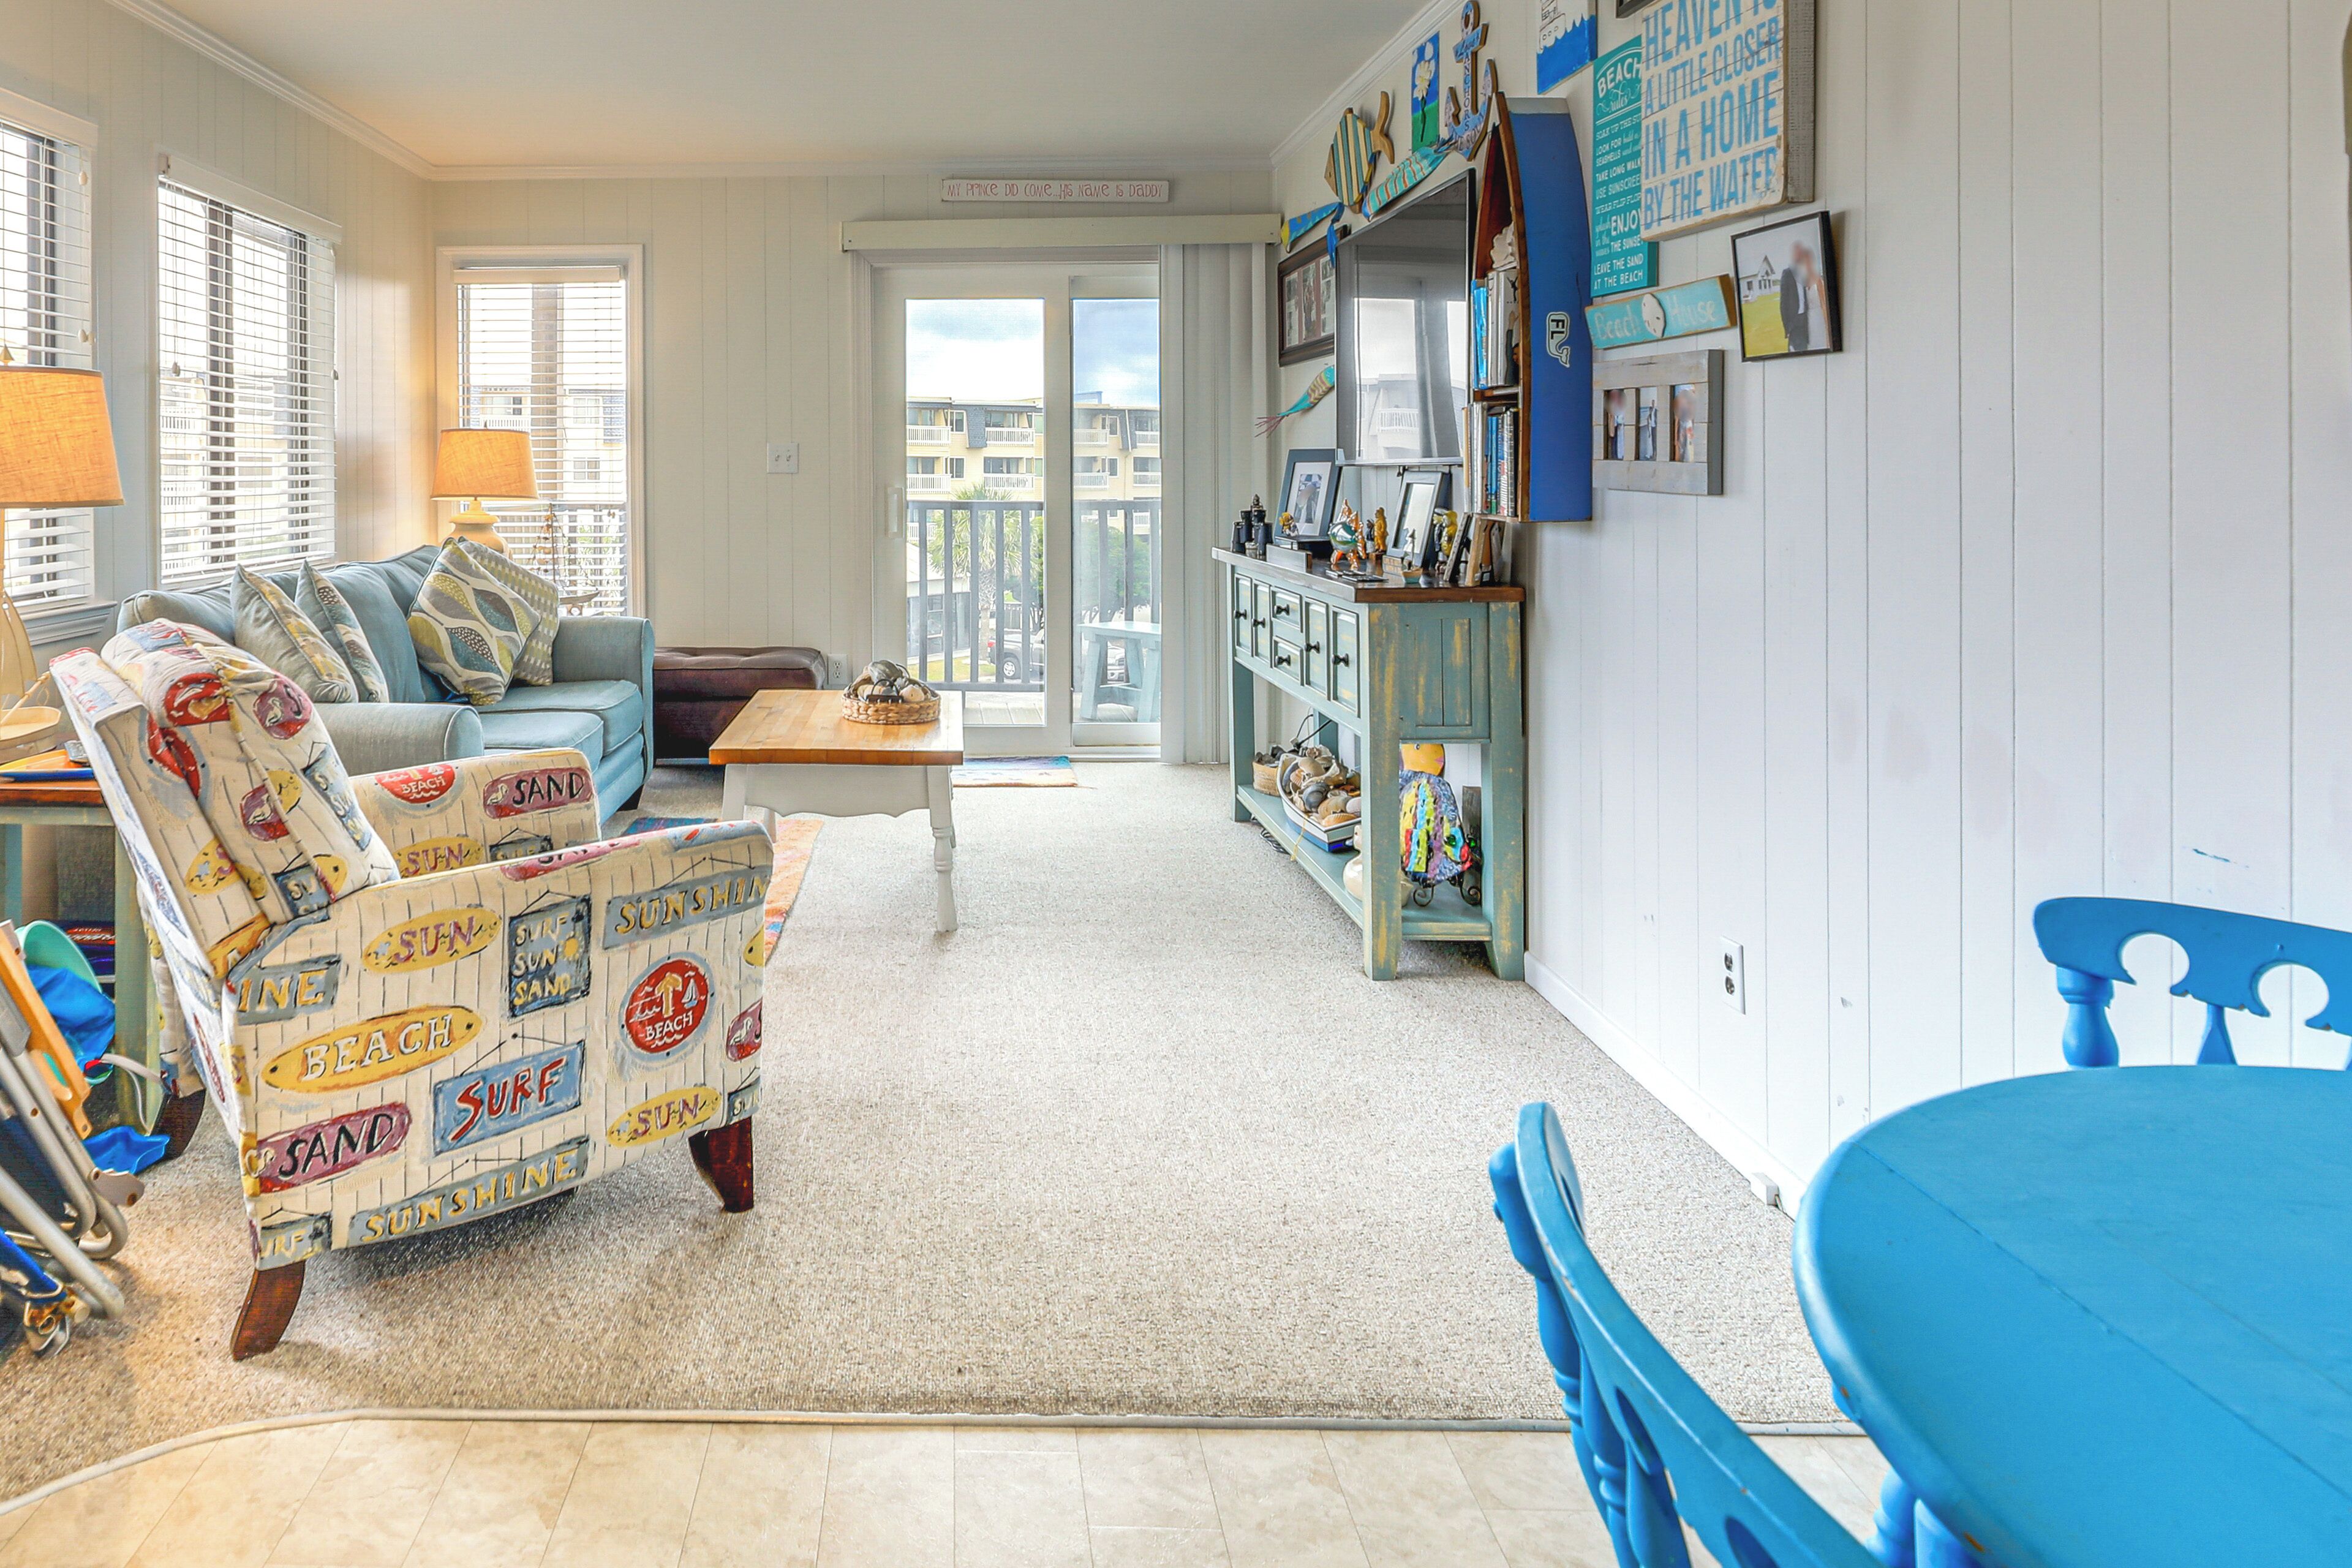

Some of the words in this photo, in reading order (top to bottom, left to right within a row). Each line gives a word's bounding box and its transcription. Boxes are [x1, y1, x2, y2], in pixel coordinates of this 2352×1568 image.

[1597, 57, 1642, 99] BEACH
[1645, 78, 1654, 118] A
[1659, 51, 1708, 111] LITTLE
[1713, 16, 1779, 86] CLOSER
[1596, 127, 1610, 140] SOAK
[1611, 124, 1619, 134] UP
[1619, 118, 1632, 130] THE
[1645, 118, 1667, 180] IN
[1675, 109, 1691, 170] A
[1701, 69, 1779, 160] HOME
[1596, 143, 1610, 156] LOOK
[1611, 138, 1622, 149] FOR
[1596, 149, 1621, 167] SEASHELLS
[1596, 173, 1608, 183] TAKE
[1610, 165, 1625, 178] LONG
[1627, 158, 1642, 172] WALK
[947, 184, 961, 197] MY
[1005, 183, 1019, 197] DID
[1116, 184, 1123, 197] IS
[1596, 186, 1607, 200] USE
[1596, 202, 1612, 214] WEAR
[1613, 197, 1626, 209] FLIP
[1644, 183, 1667, 231] BY
[1670, 170, 1705, 223] THE
[1611, 239, 1621, 253] THE
[1594, 262, 1611, 276] LEAVE
[1613, 257, 1625, 271] THE
[1627, 253, 1644, 267] SAND
[1594, 279, 1601, 290] AT
[1604, 274, 1617, 288] THE
[1620, 270, 1643, 285] BEACH
[1595, 304, 1642, 340] Beach
[1666, 294, 1716, 326] House
[401, 775, 447, 794] BEACH
[512, 772, 584, 807] SAND
[405, 843, 464, 876] SUN
[393, 916, 475, 964] SUN
[515, 912, 570, 946] SURF
[512, 944, 559, 979] SUN
[513, 973, 571, 1006] SAND
[645, 1011, 693, 1041] BEACH
[301, 1014, 453, 1082] BEACH
[451, 1057, 565, 1142] SURF
[633, 1094, 701, 1137] SUN
[279, 1113, 394, 1179] SAND
[362, 1148, 579, 1243] SUNSHINE
